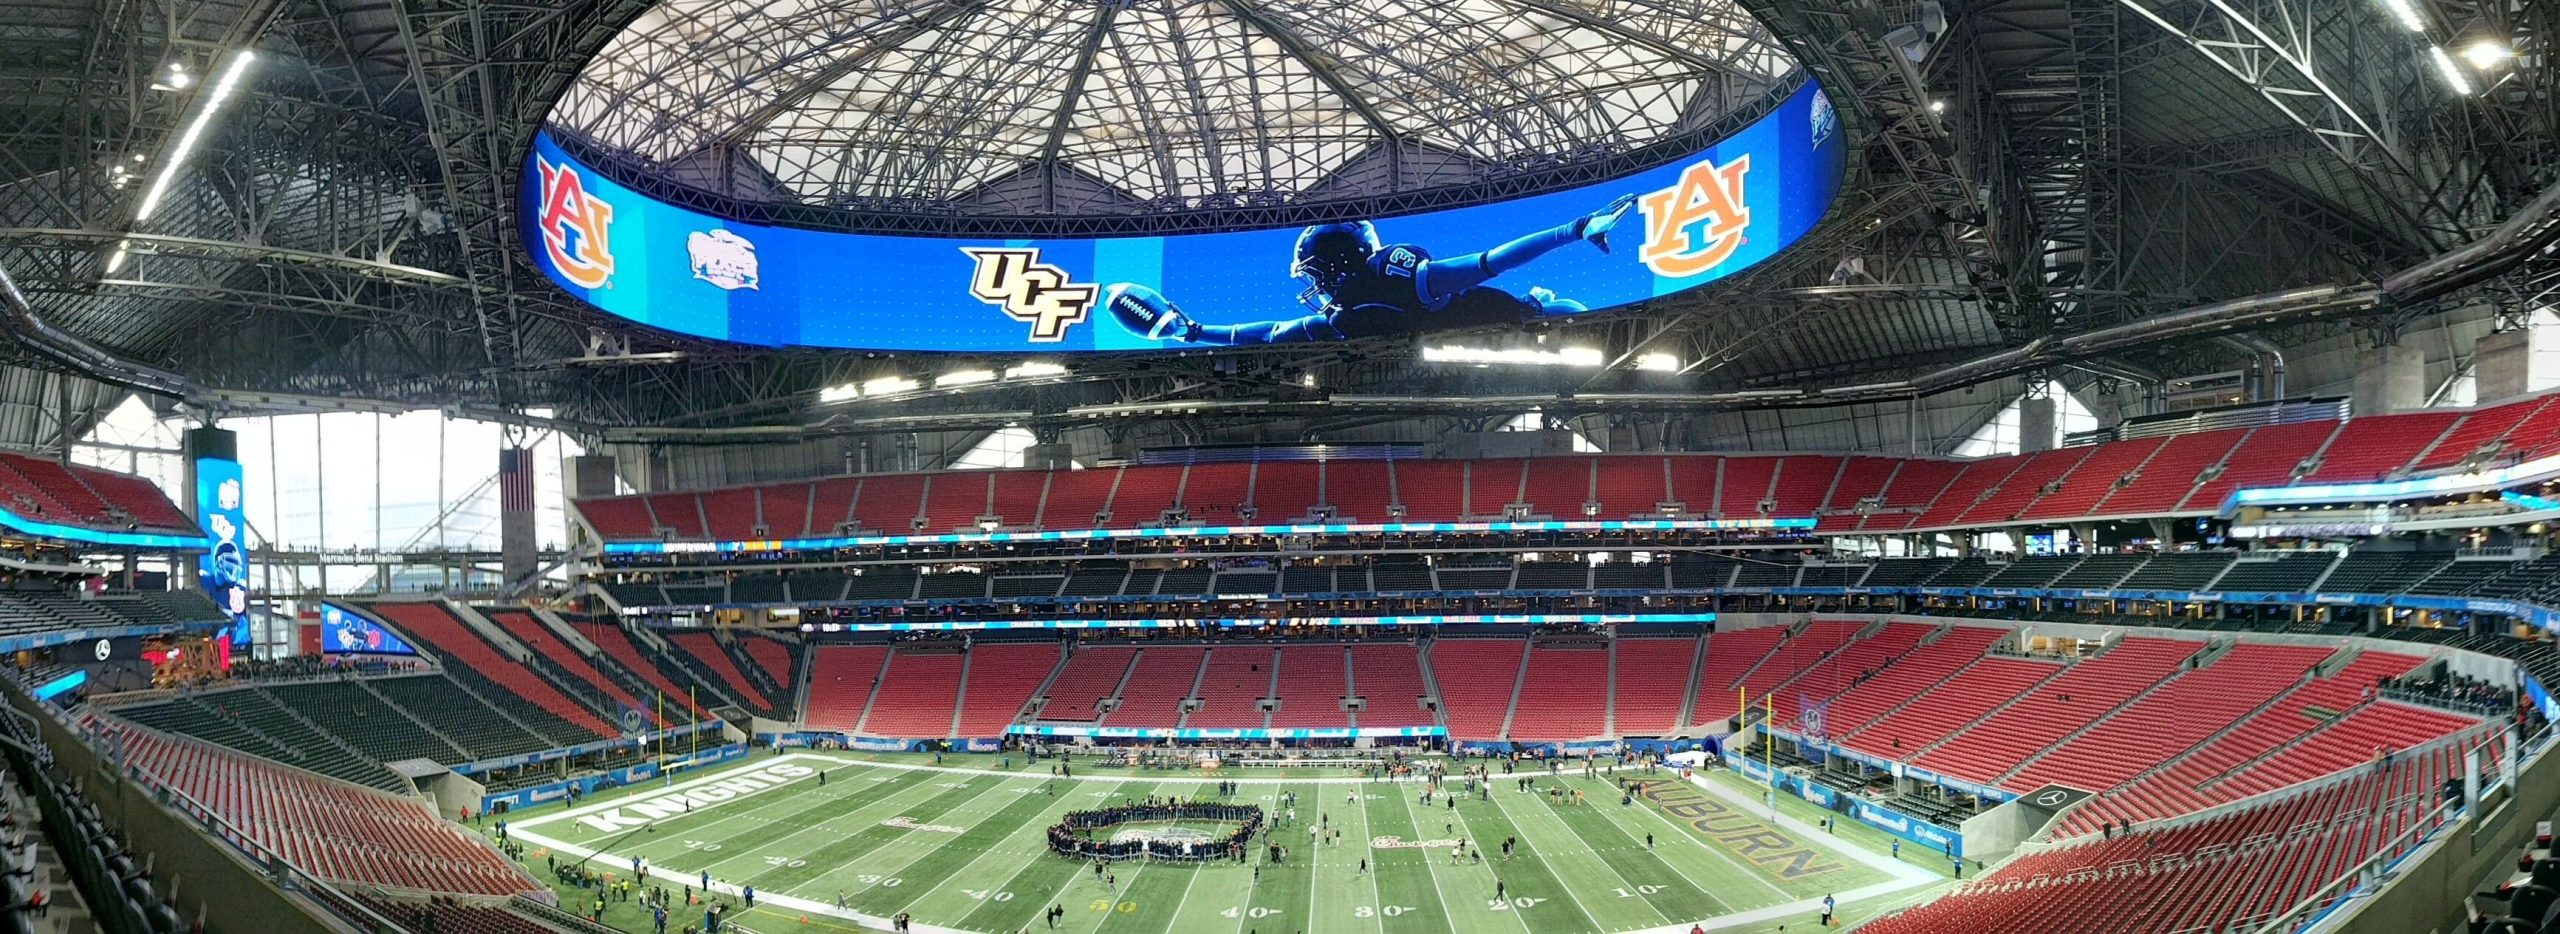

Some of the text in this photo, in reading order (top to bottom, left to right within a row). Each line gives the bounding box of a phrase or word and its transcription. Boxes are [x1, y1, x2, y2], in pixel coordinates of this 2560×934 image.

[1385, 247, 1417, 278] 13
[958, 246, 1100, 343] UCF
[319, 552, 404, 564] Mercedes-Benz Stadium
[578, 762, 815, 834] KNIGHTS
[1626, 778, 1847, 881] AUBURN
[1611, 885, 1658, 899] 10
[1089, 899, 1138, 913] 50
[1488, 897, 1535, 911] 20
[1220, 905, 1268, 919] 40
[1354, 904, 1403, 919] 30
